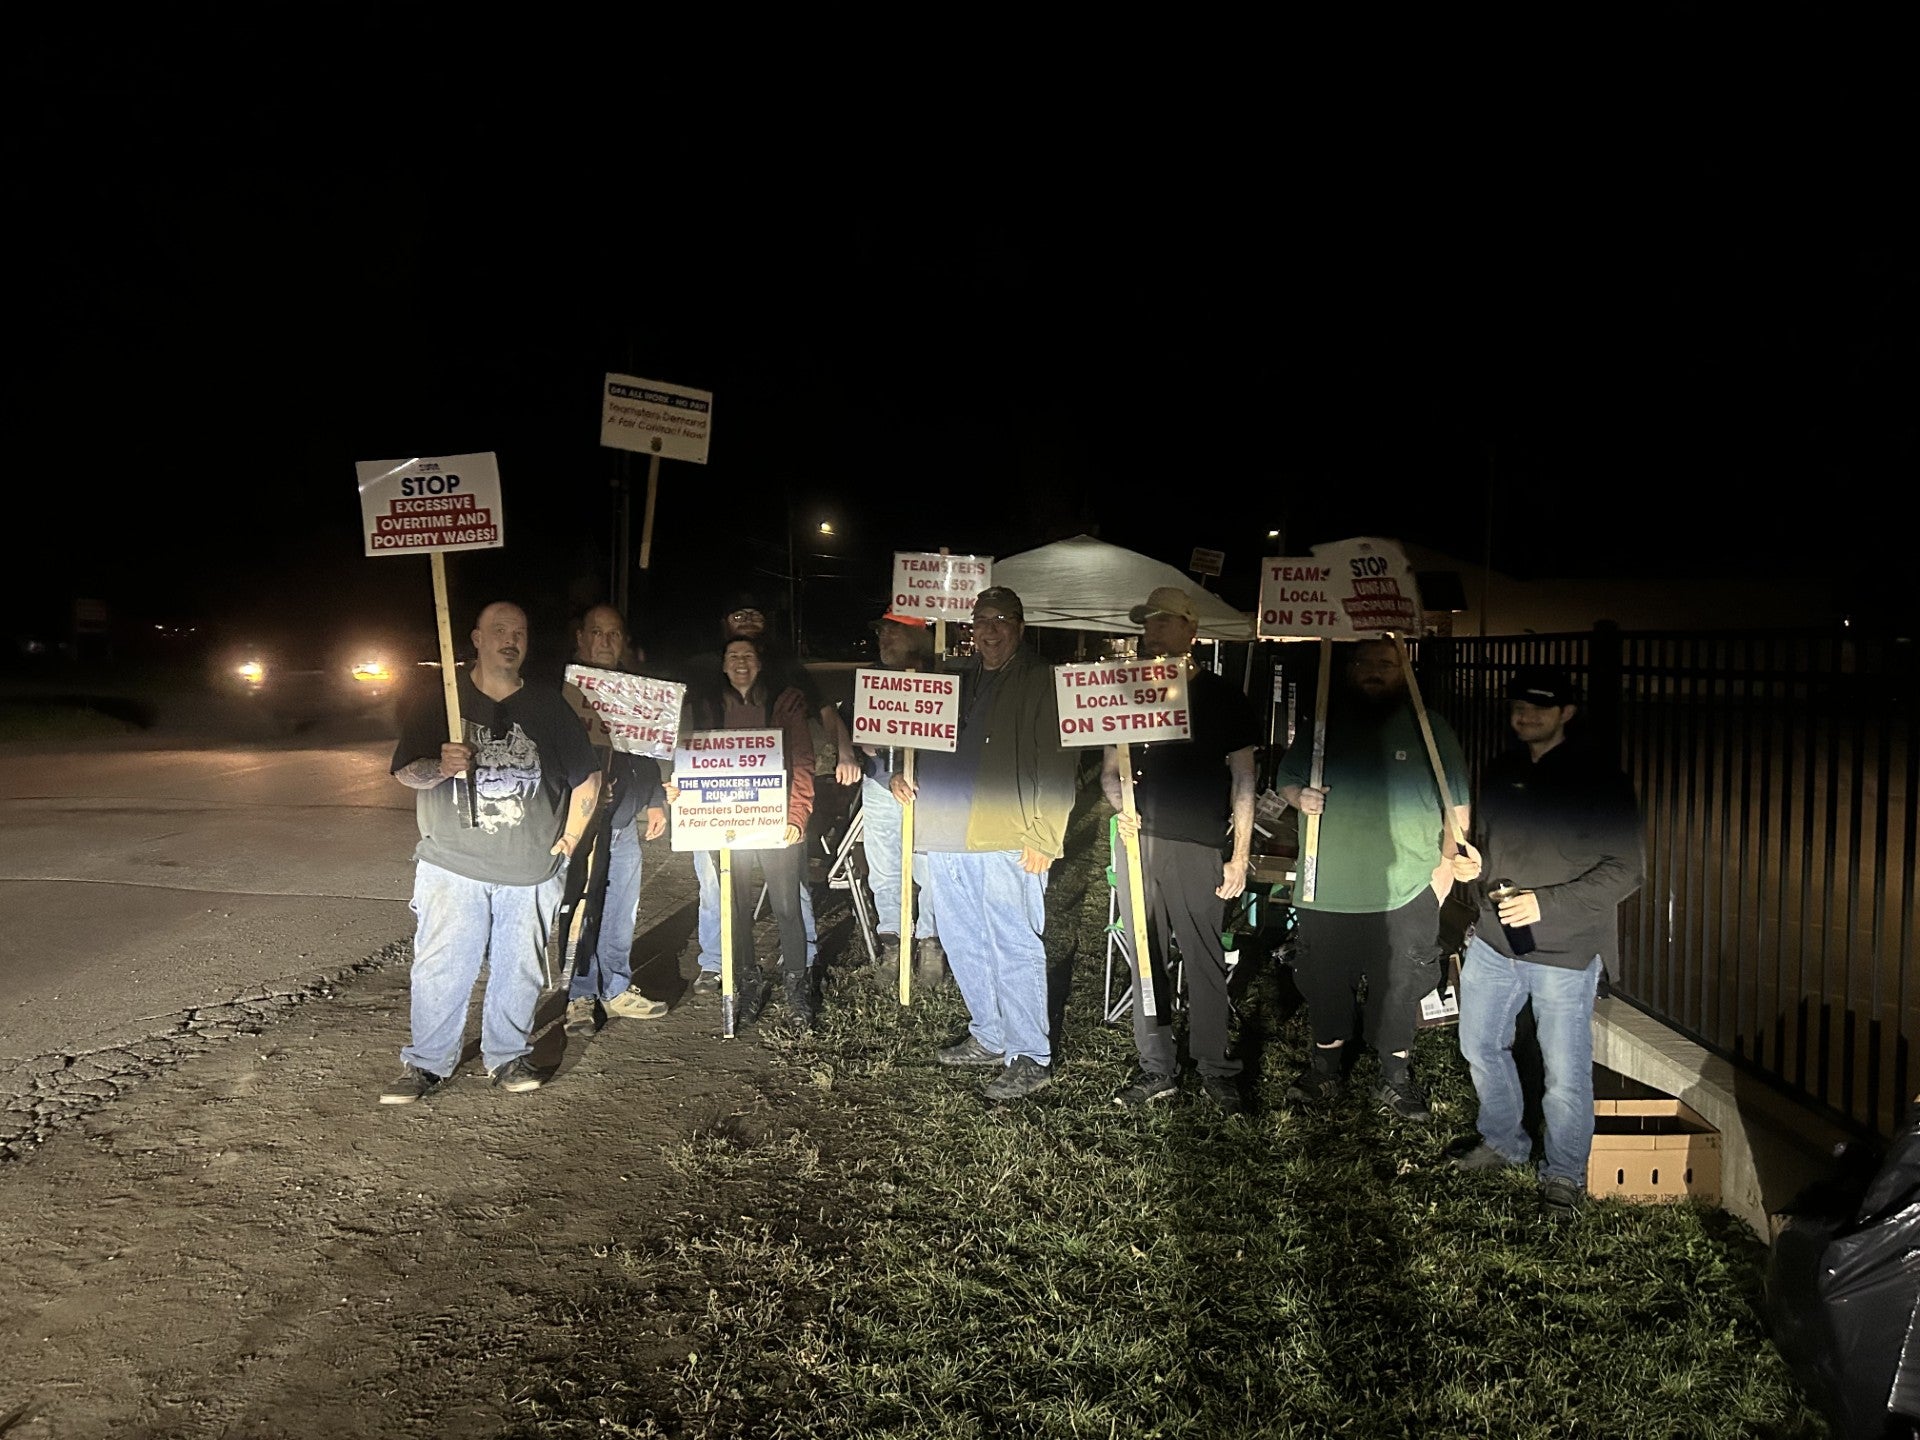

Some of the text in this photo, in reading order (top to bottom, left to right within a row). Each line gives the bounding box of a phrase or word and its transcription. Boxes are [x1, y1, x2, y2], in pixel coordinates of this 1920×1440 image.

[628, 389, 644, 400] ALL
[676, 399, 688, 408] NO
[638, 421, 681, 435] Contract
[401, 475, 460, 496] STOP
[396, 496, 471, 513] EXCESSIVE
[381, 512, 487, 531] OVERTIME AND
[374, 528, 495, 547] POVERTY WAGES!
[1350, 556, 1387, 577] STOP
[951, 580, 976, 590] 597
[896, 594, 976, 609] ON STRIK
[1264, 610, 1293, 624] ON
[1062, 664, 1178, 687] TEAMSTERS
[862, 675, 952, 694] TEAMSTERS
[1134, 687, 1168, 704] 597
[914, 700, 944, 715] 597
[856, 716, 956, 740] ON STRIKE
[1062, 710, 1188, 734] ON STRIKE
[600, 720, 676, 745] STRIKE
[684, 736, 776, 750] TEAMSTERS
[738, 754, 766, 767] 597
[680, 778, 780, 788] THE WORKERS HAVE
[706, 790, 727, 800] RUN
[678, 804, 782, 816] Teamsters Demand
[678, 817, 784, 828] A Fair Contract Now!
